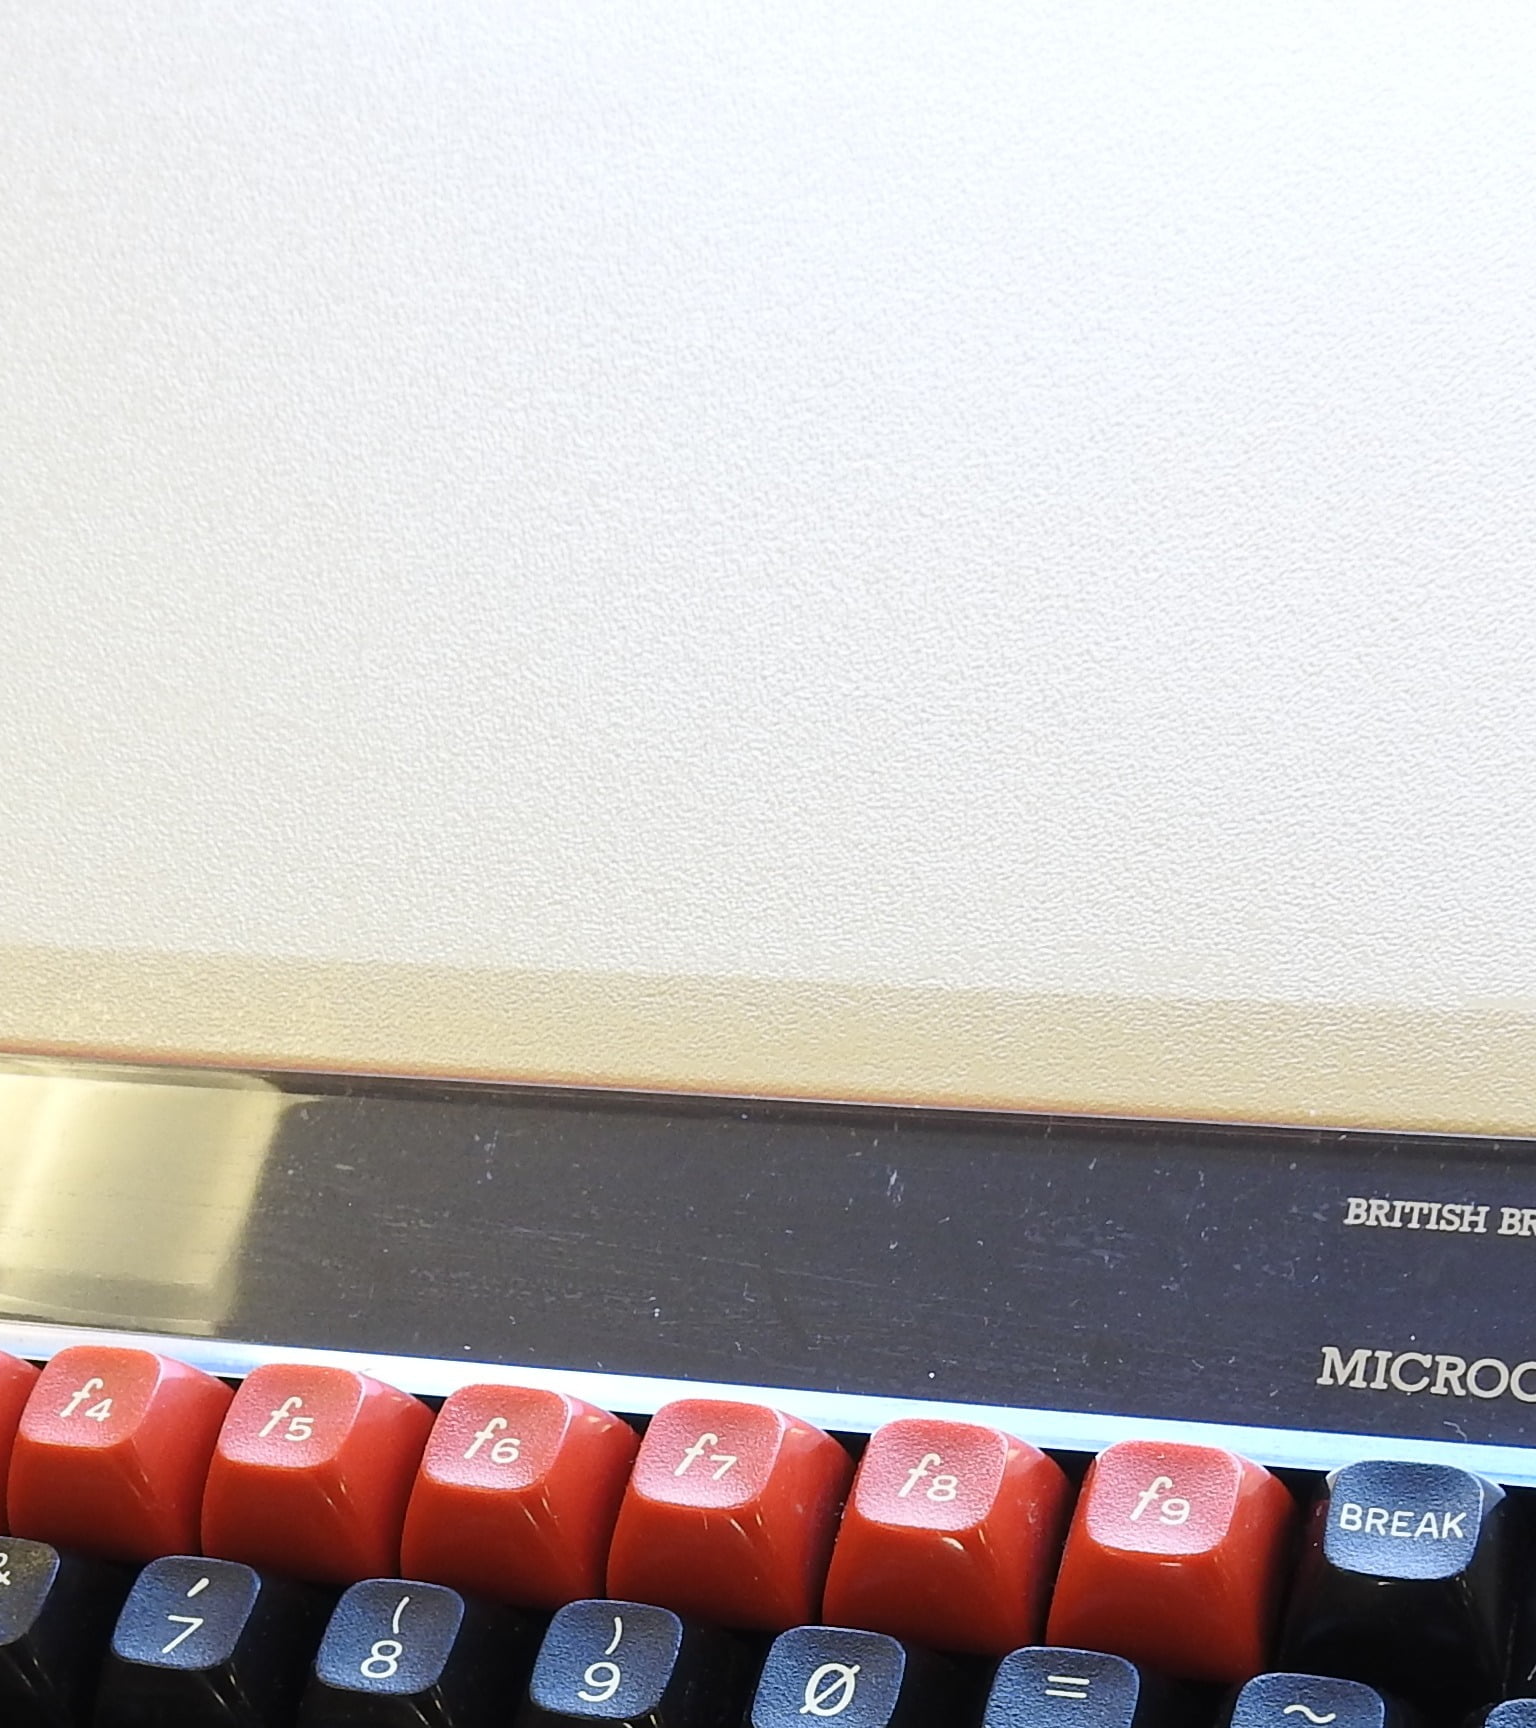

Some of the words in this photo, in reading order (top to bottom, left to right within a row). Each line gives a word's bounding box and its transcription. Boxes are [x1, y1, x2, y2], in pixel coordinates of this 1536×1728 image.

[1343, 1196, 1489, 1236] BRITISH
[60, 1378, 112, 1421] f4
[258, 1397, 314, 1441] f5
[464, 1417, 521, 1464] f6
[674, 1432, 738, 1479] f7
[896, 1454, 958, 1501] f8
[1130, 1477, 1191, 1525] f9
[1339, 1503, 1466, 1540] BREAK
[162, 1615, 203, 1653] 7
[393, 1597, 409, 1634] (
[605, 1617, 622, 1654] )
[361, 1640, 402, 1678] 8
[578, 1662, 620, 1702] 9
